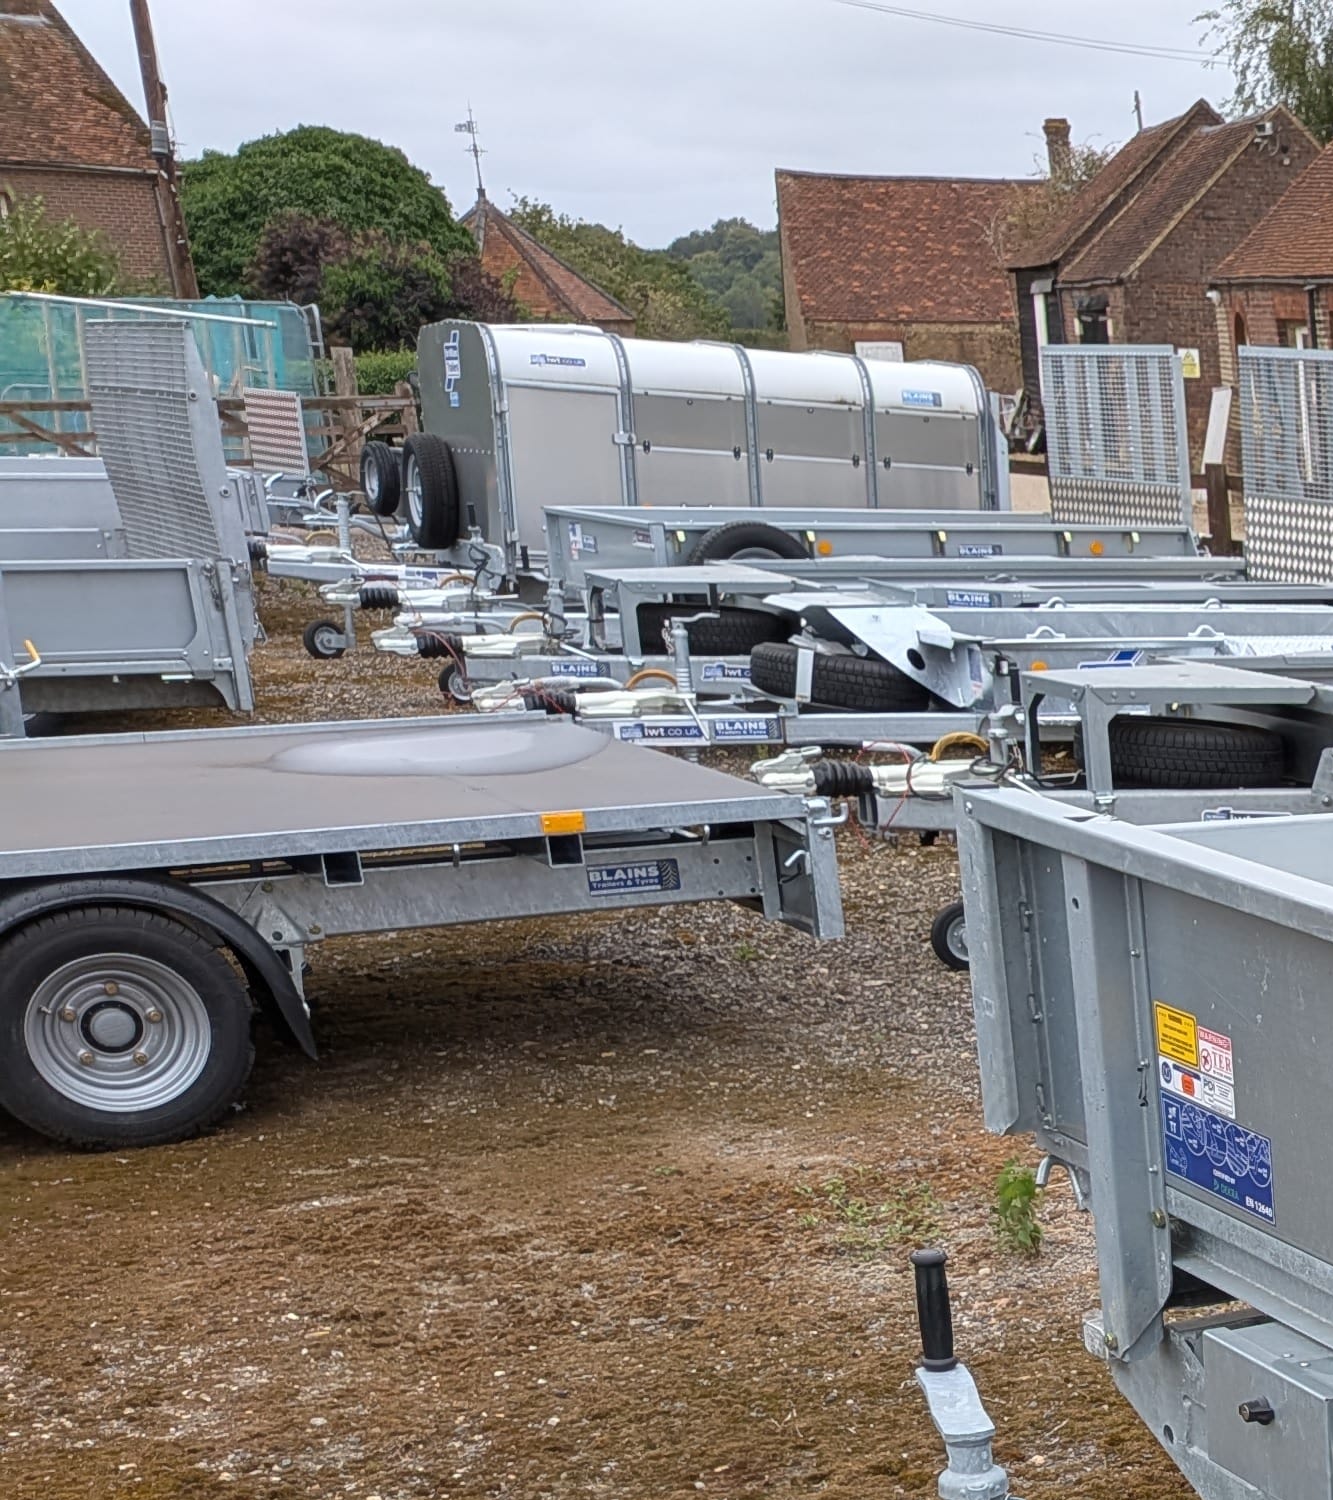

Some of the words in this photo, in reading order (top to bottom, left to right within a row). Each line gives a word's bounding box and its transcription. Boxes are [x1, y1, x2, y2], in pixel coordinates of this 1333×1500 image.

[948, 593, 990, 604] BLAINS
[552, 663, 598, 674] BLAINS
[715, 720, 768, 731] BLAINS
[644, 725, 700, 738] iwt.co.uk
[588, 866, 660, 883] BLAINS
